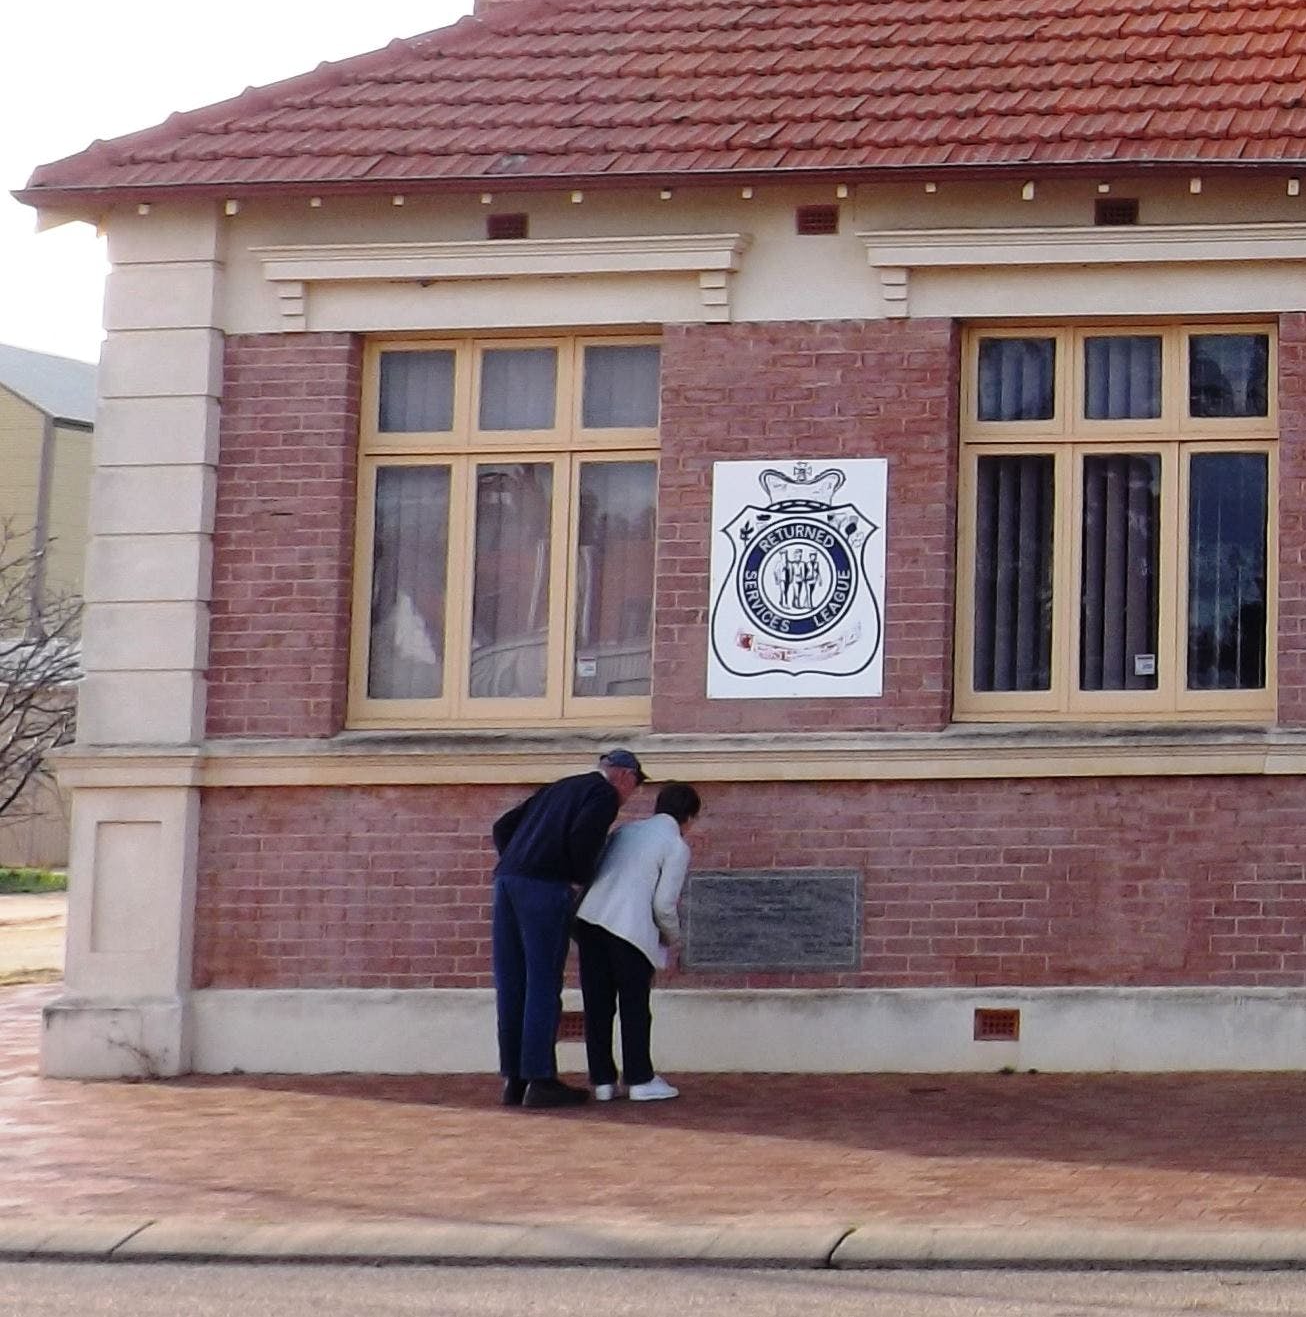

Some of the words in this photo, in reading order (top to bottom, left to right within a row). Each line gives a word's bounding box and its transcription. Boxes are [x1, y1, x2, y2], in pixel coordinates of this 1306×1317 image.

[759, 522, 835, 554] RETURNED
[745, 569, 791, 633] SERVICES
[813, 569, 850, 628] LEAGUE
